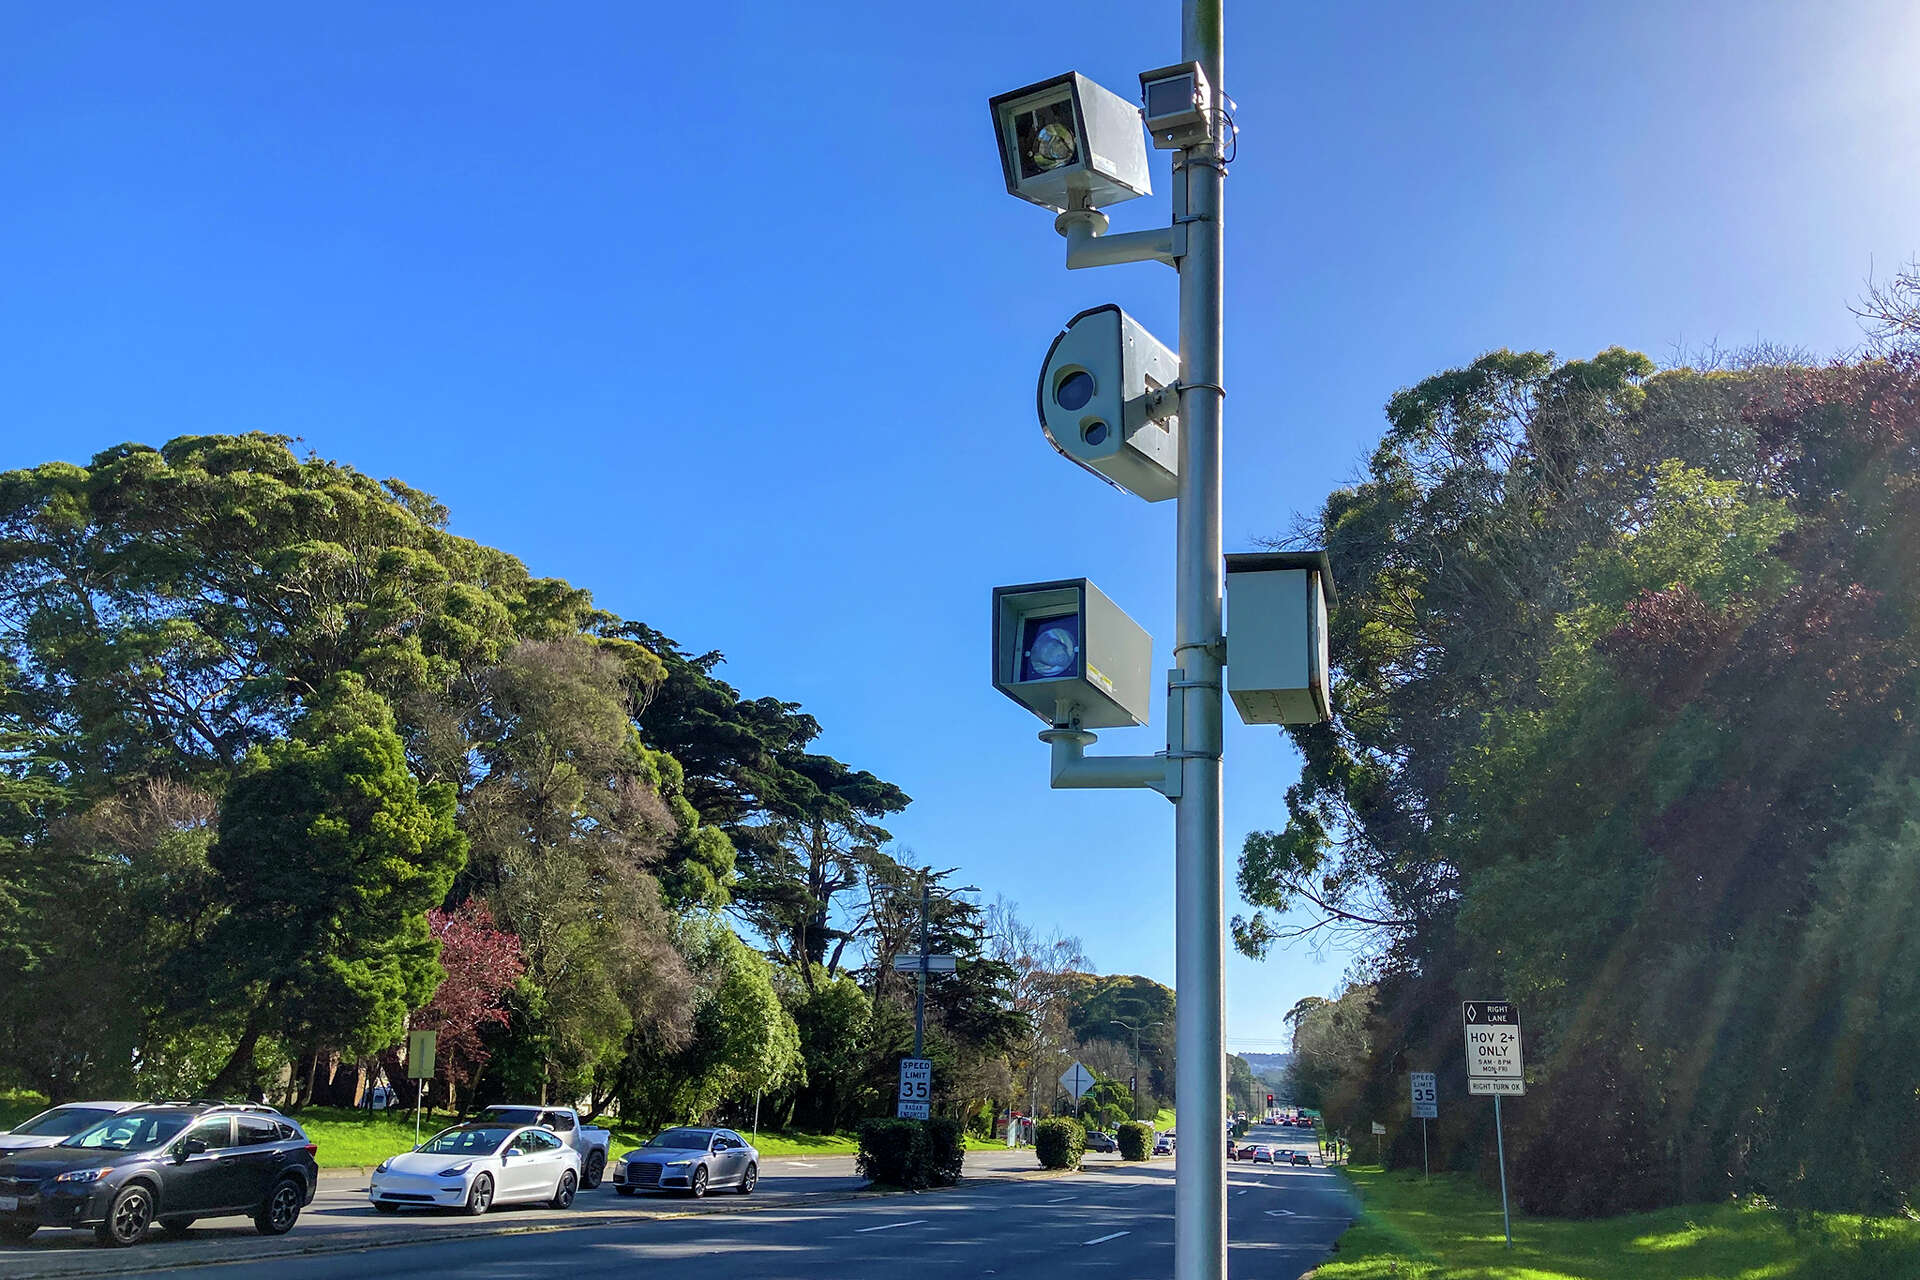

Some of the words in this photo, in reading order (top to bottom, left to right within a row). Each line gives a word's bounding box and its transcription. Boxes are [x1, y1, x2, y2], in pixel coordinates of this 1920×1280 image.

[1471, 1033, 1494, 1043] HOV
[1500, 1033, 1515, 1043] 2+
[1479, 1046, 1508, 1056] ONLY
[902, 1082, 927, 1097] 35
[1414, 1089, 1435, 1101] 35
